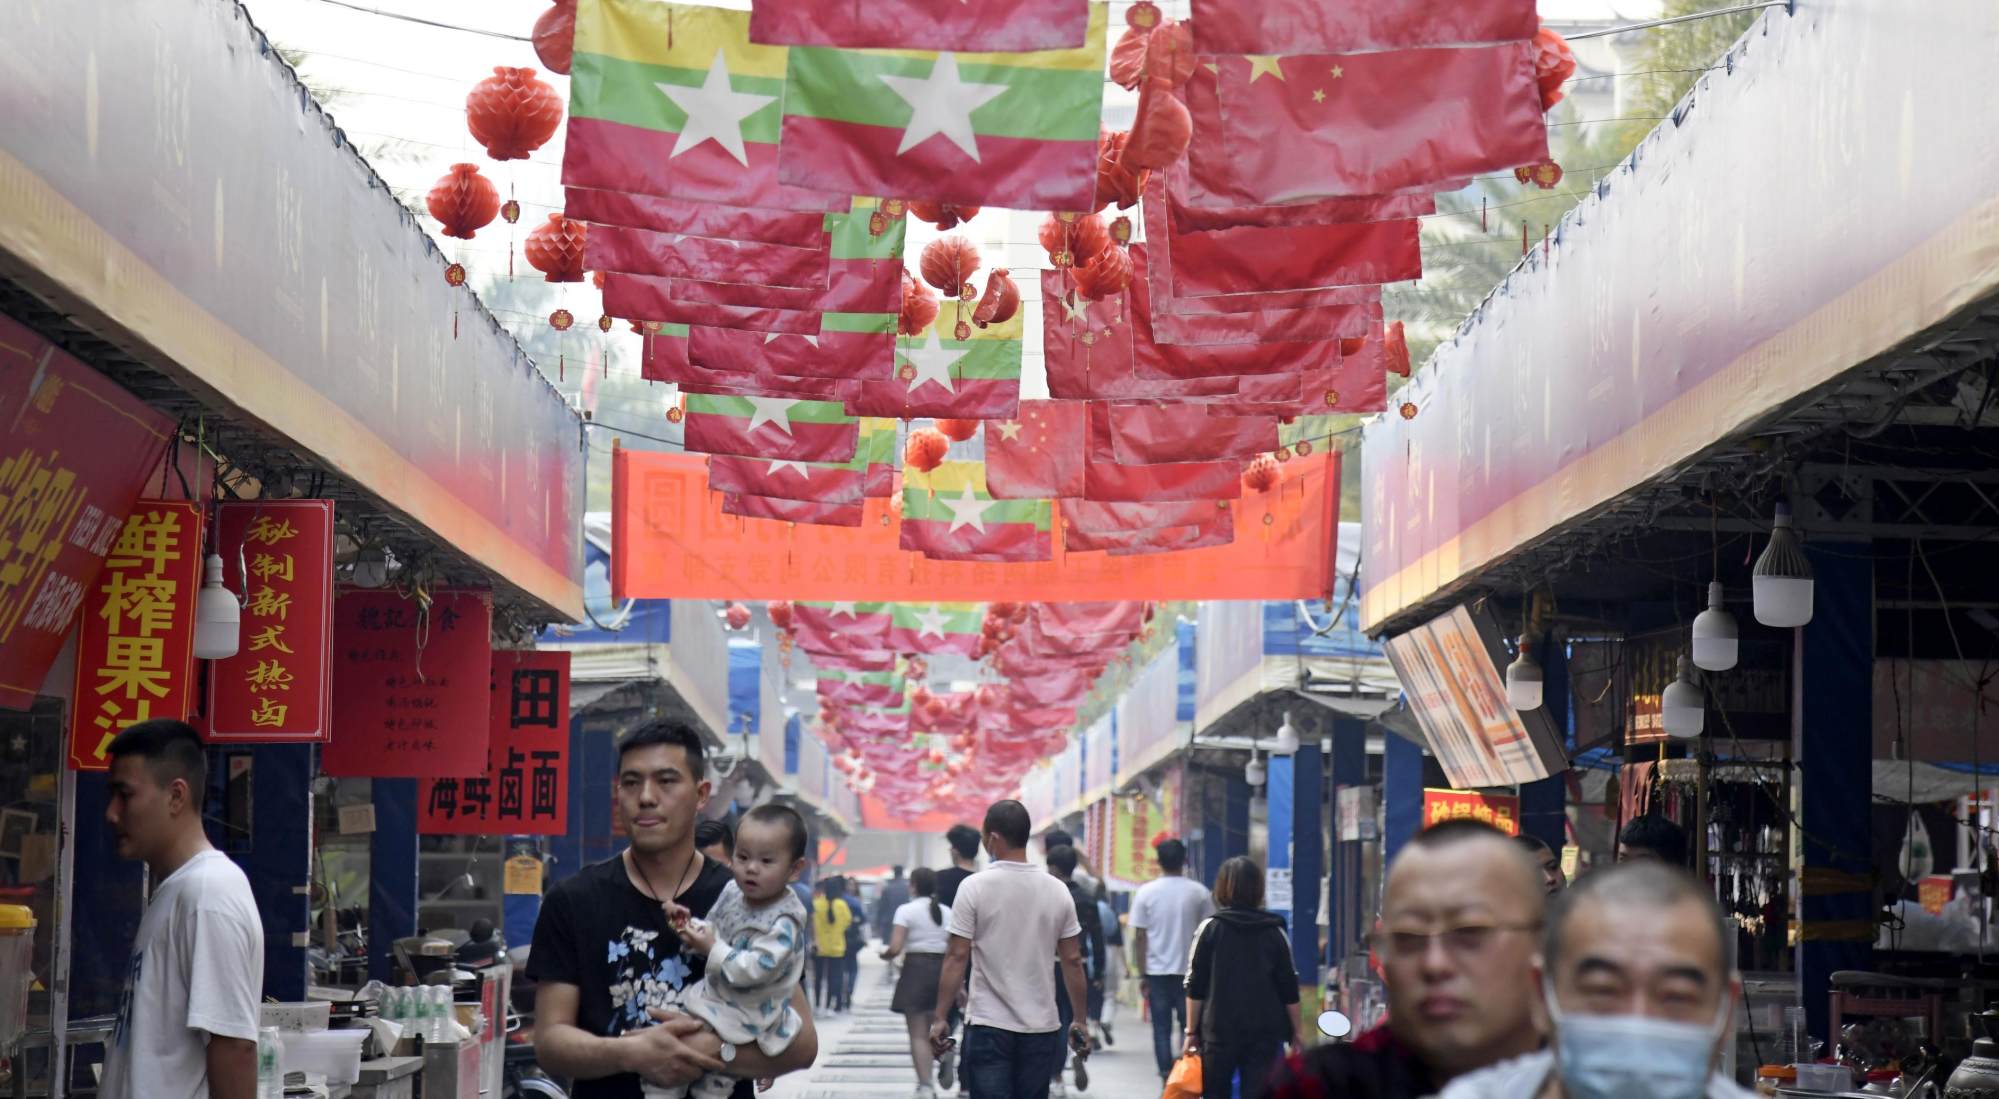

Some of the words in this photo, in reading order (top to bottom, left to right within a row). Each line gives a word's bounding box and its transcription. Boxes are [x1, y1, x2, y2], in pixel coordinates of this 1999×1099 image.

[245, 516, 299, 728] 秘制新式热卤
